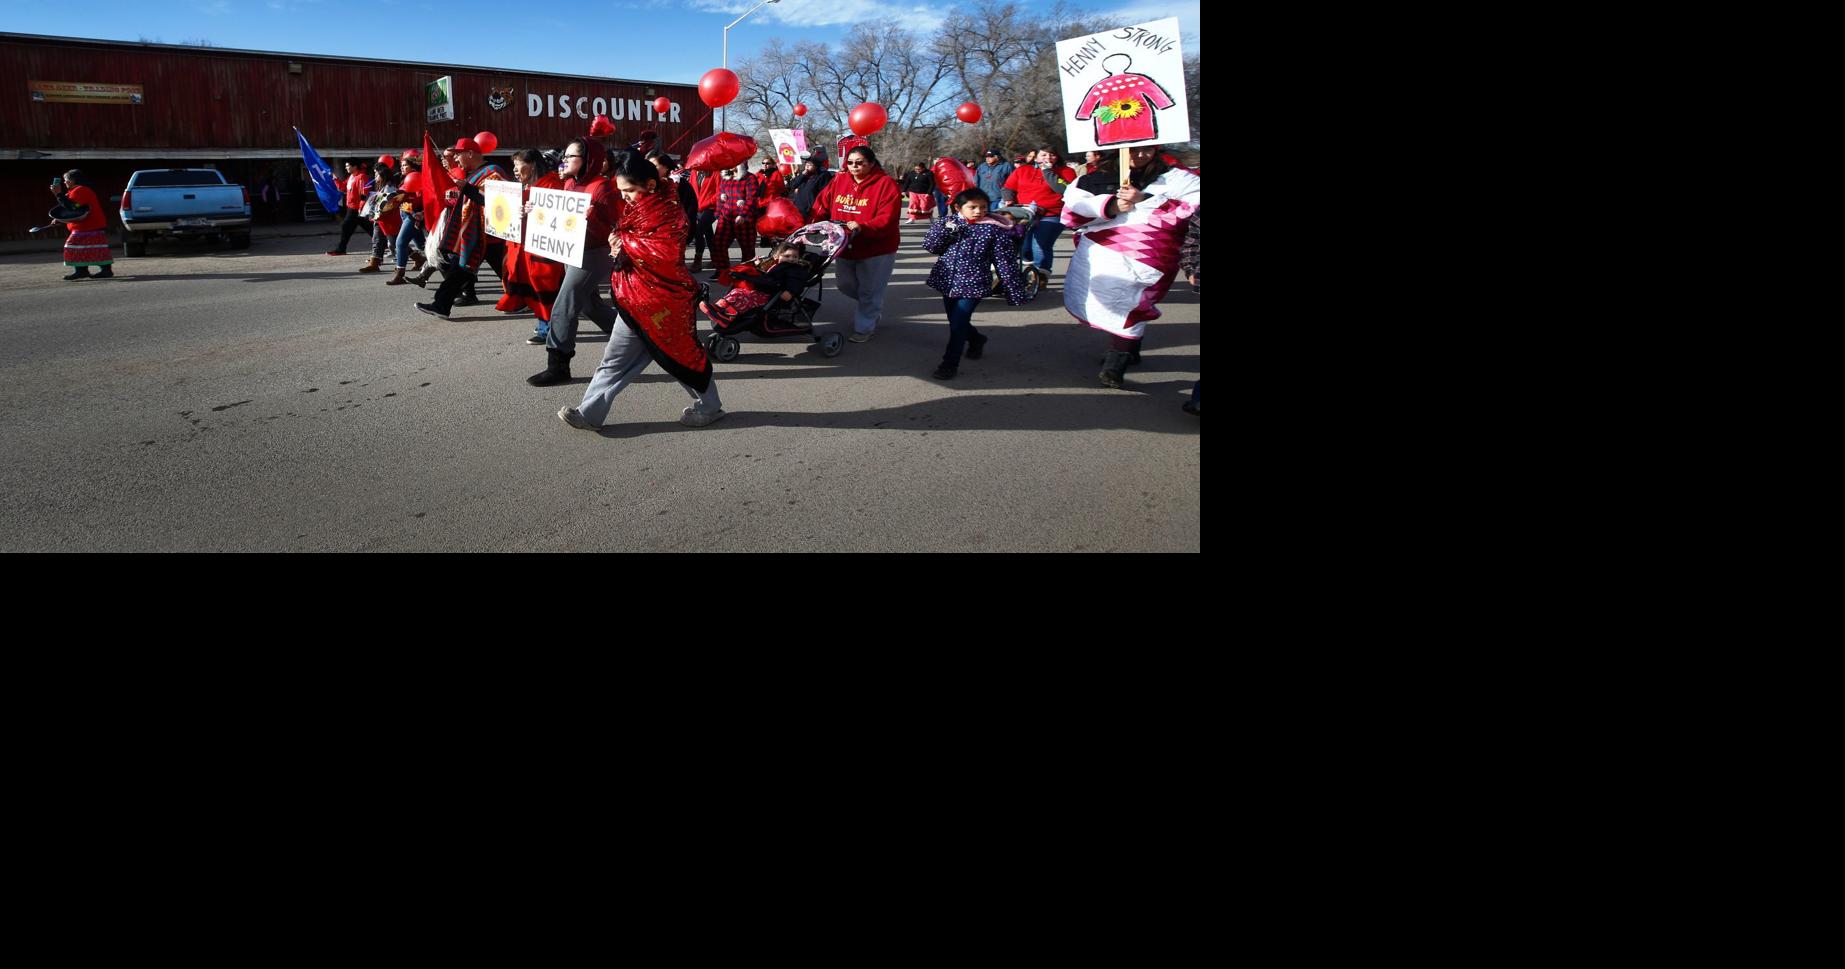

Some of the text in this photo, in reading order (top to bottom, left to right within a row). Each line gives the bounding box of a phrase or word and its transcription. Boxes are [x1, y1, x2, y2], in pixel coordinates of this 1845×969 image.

[1060, 26, 1177, 77] HENNY STRONG
[532, 192, 586, 215] JUSTICE
[550, 217, 557, 231] 4
[532, 233, 575, 258] HENNY
